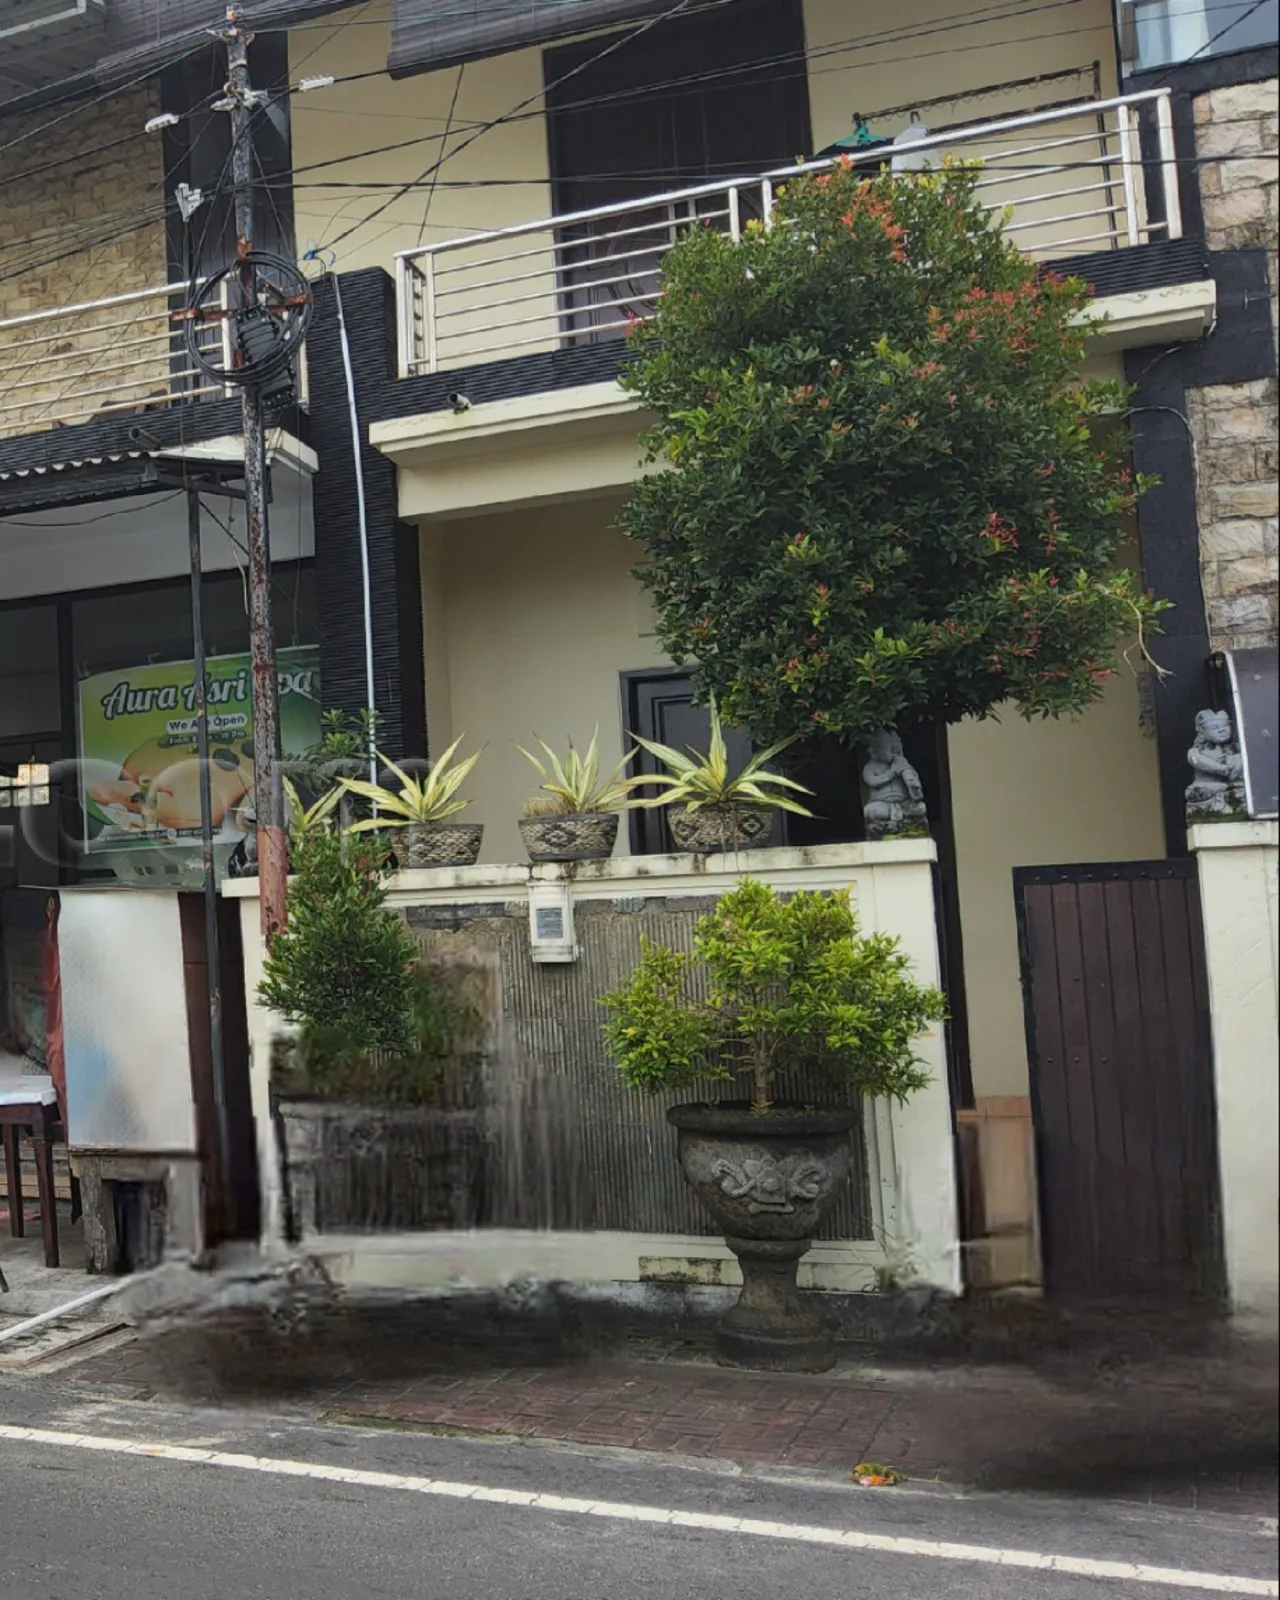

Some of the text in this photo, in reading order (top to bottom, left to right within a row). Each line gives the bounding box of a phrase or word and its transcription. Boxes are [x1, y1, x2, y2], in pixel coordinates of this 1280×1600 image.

[102, 680, 177, 718] Aura
[169, 721, 188, 730] We
[213, 715, 245, 728] Open
